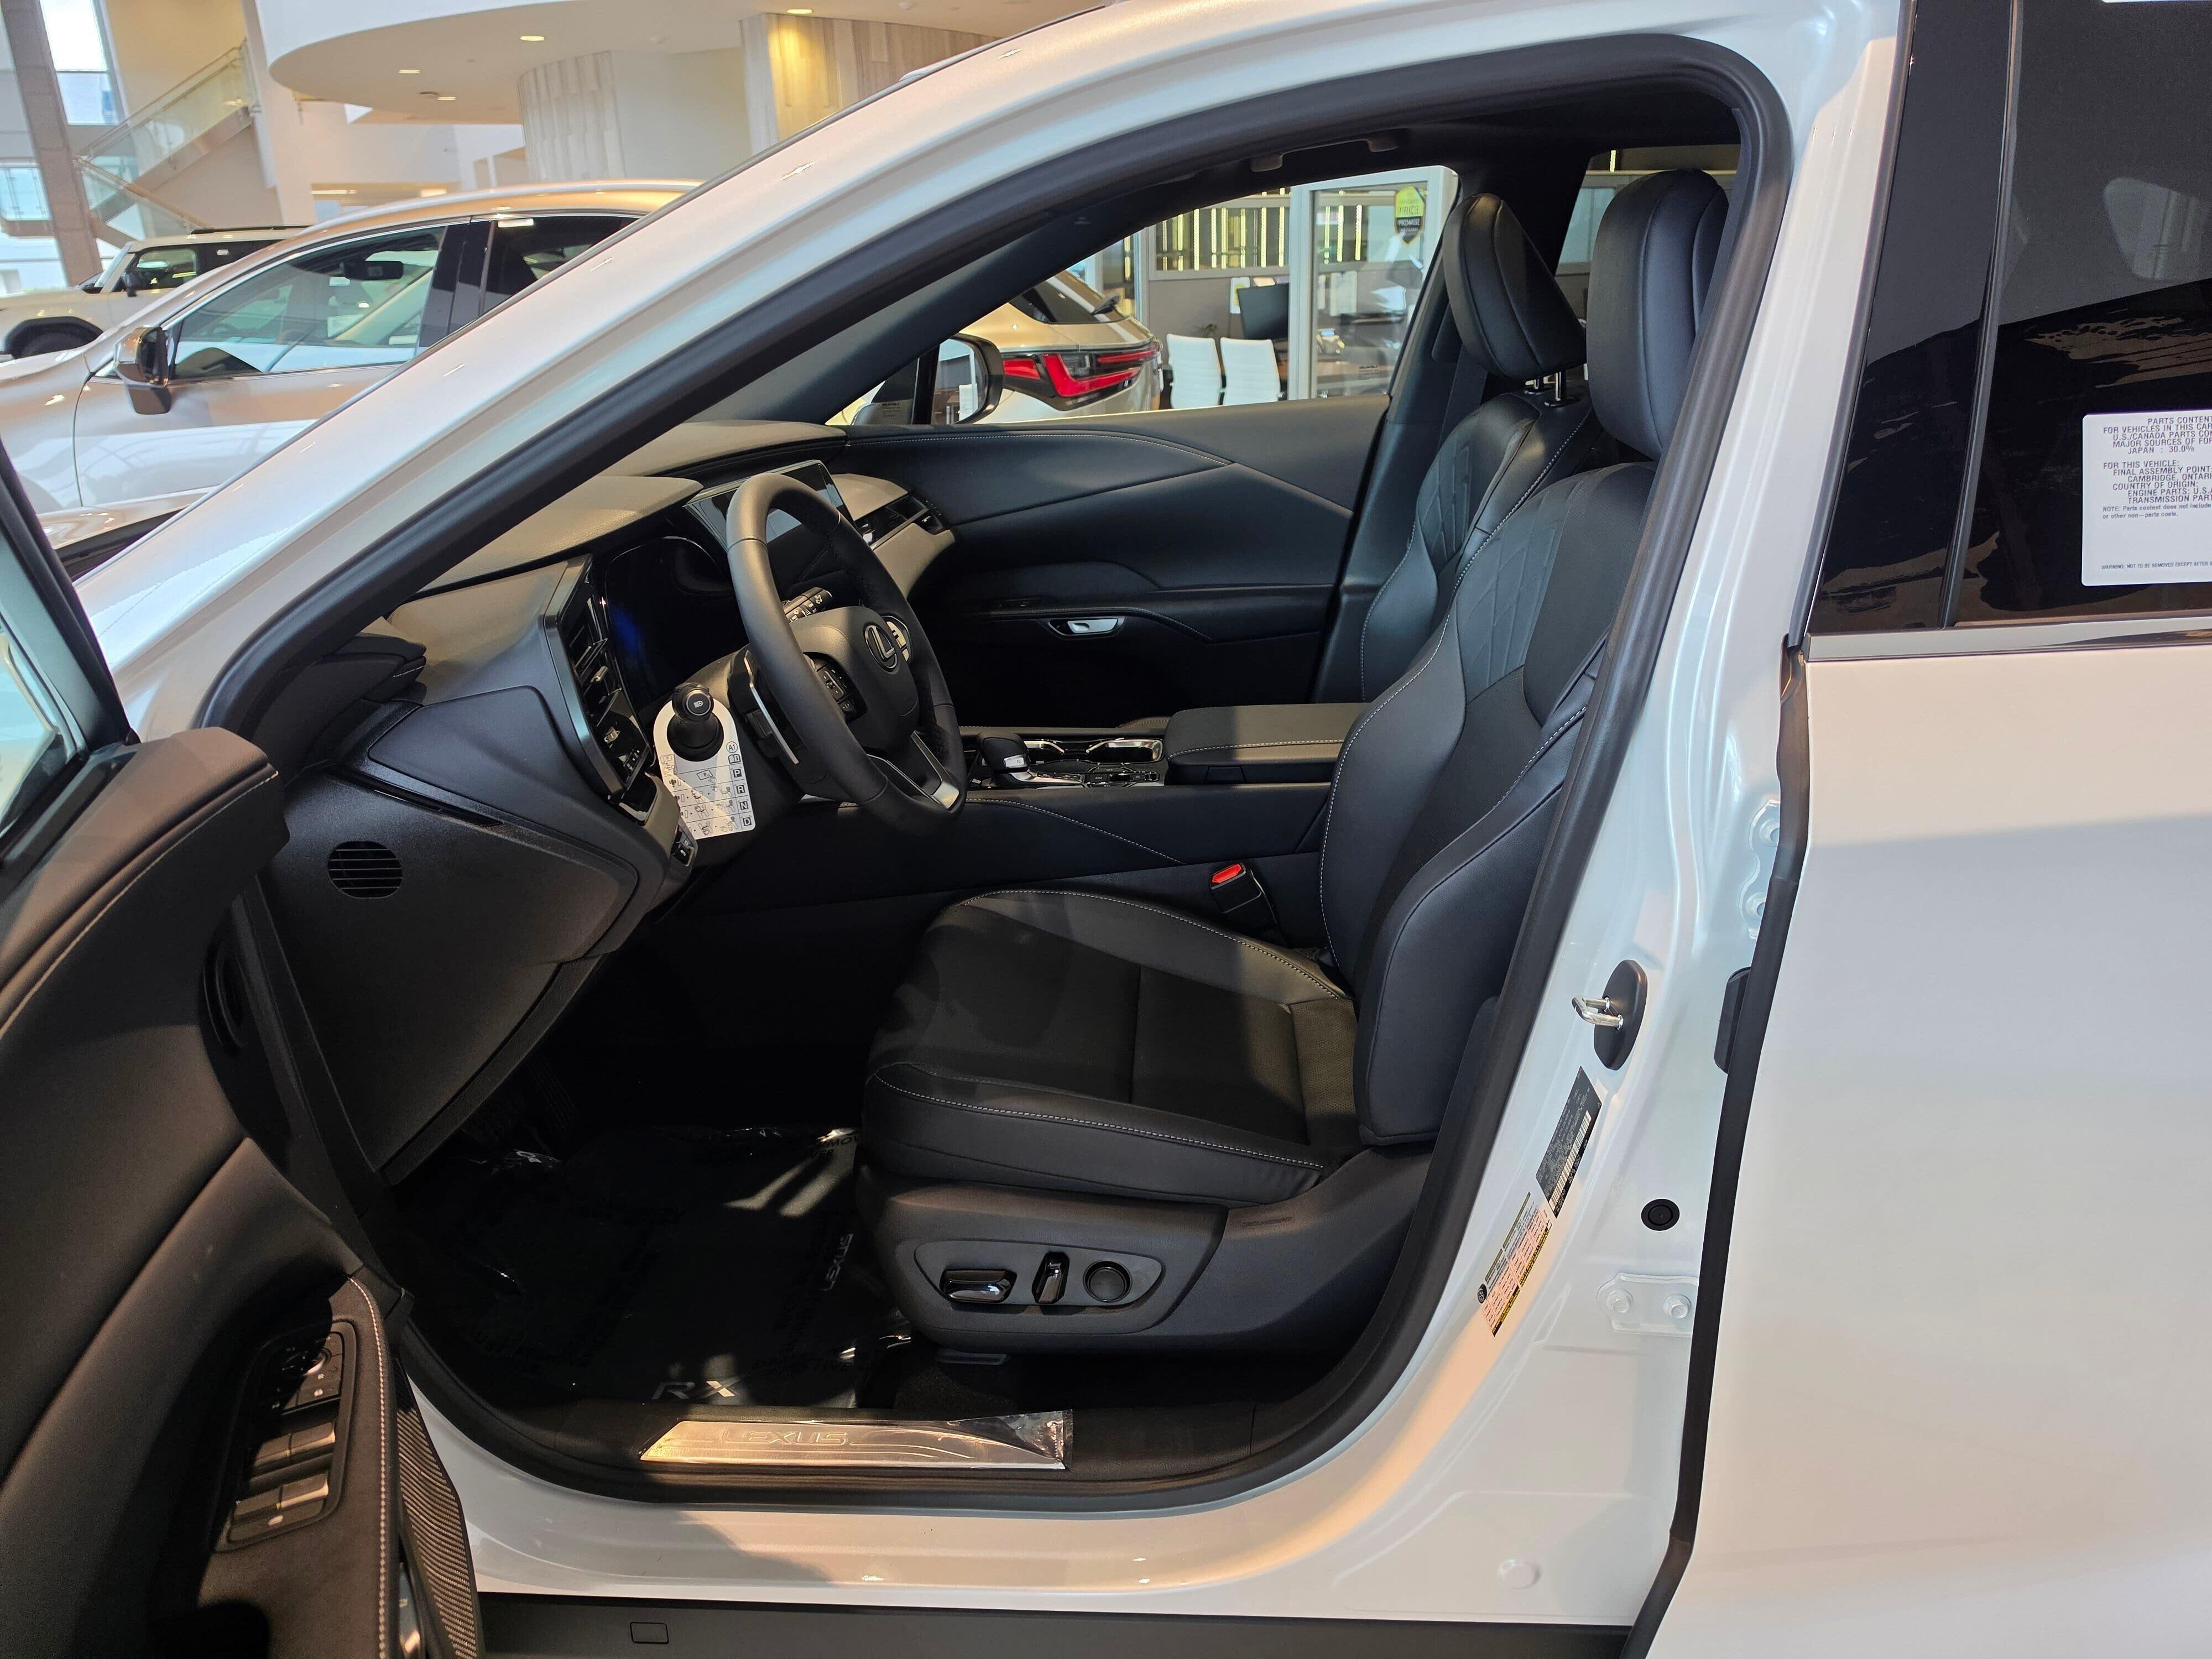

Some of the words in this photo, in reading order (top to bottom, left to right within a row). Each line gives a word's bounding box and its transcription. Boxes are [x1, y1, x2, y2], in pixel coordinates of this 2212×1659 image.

[2112, 432, 2166, 441] U.S./CANADA
[2112, 440, 2141, 448] MAJOR
[2145, 438, 2182, 446] SOURCES
[2168, 445, 2194, 453] 30.0%
[2139, 467, 2183, 475] ASSEMBLY
[2127, 474, 2179, 482] CAMBRIDGE,
[2112, 482, 2151, 491] COUNTRY
[2127, 495, 2189, 504] TRANSMISSION
[650, 1376, 743, 1400] RX
[721, 1428, 847, 1446] LEXUS
